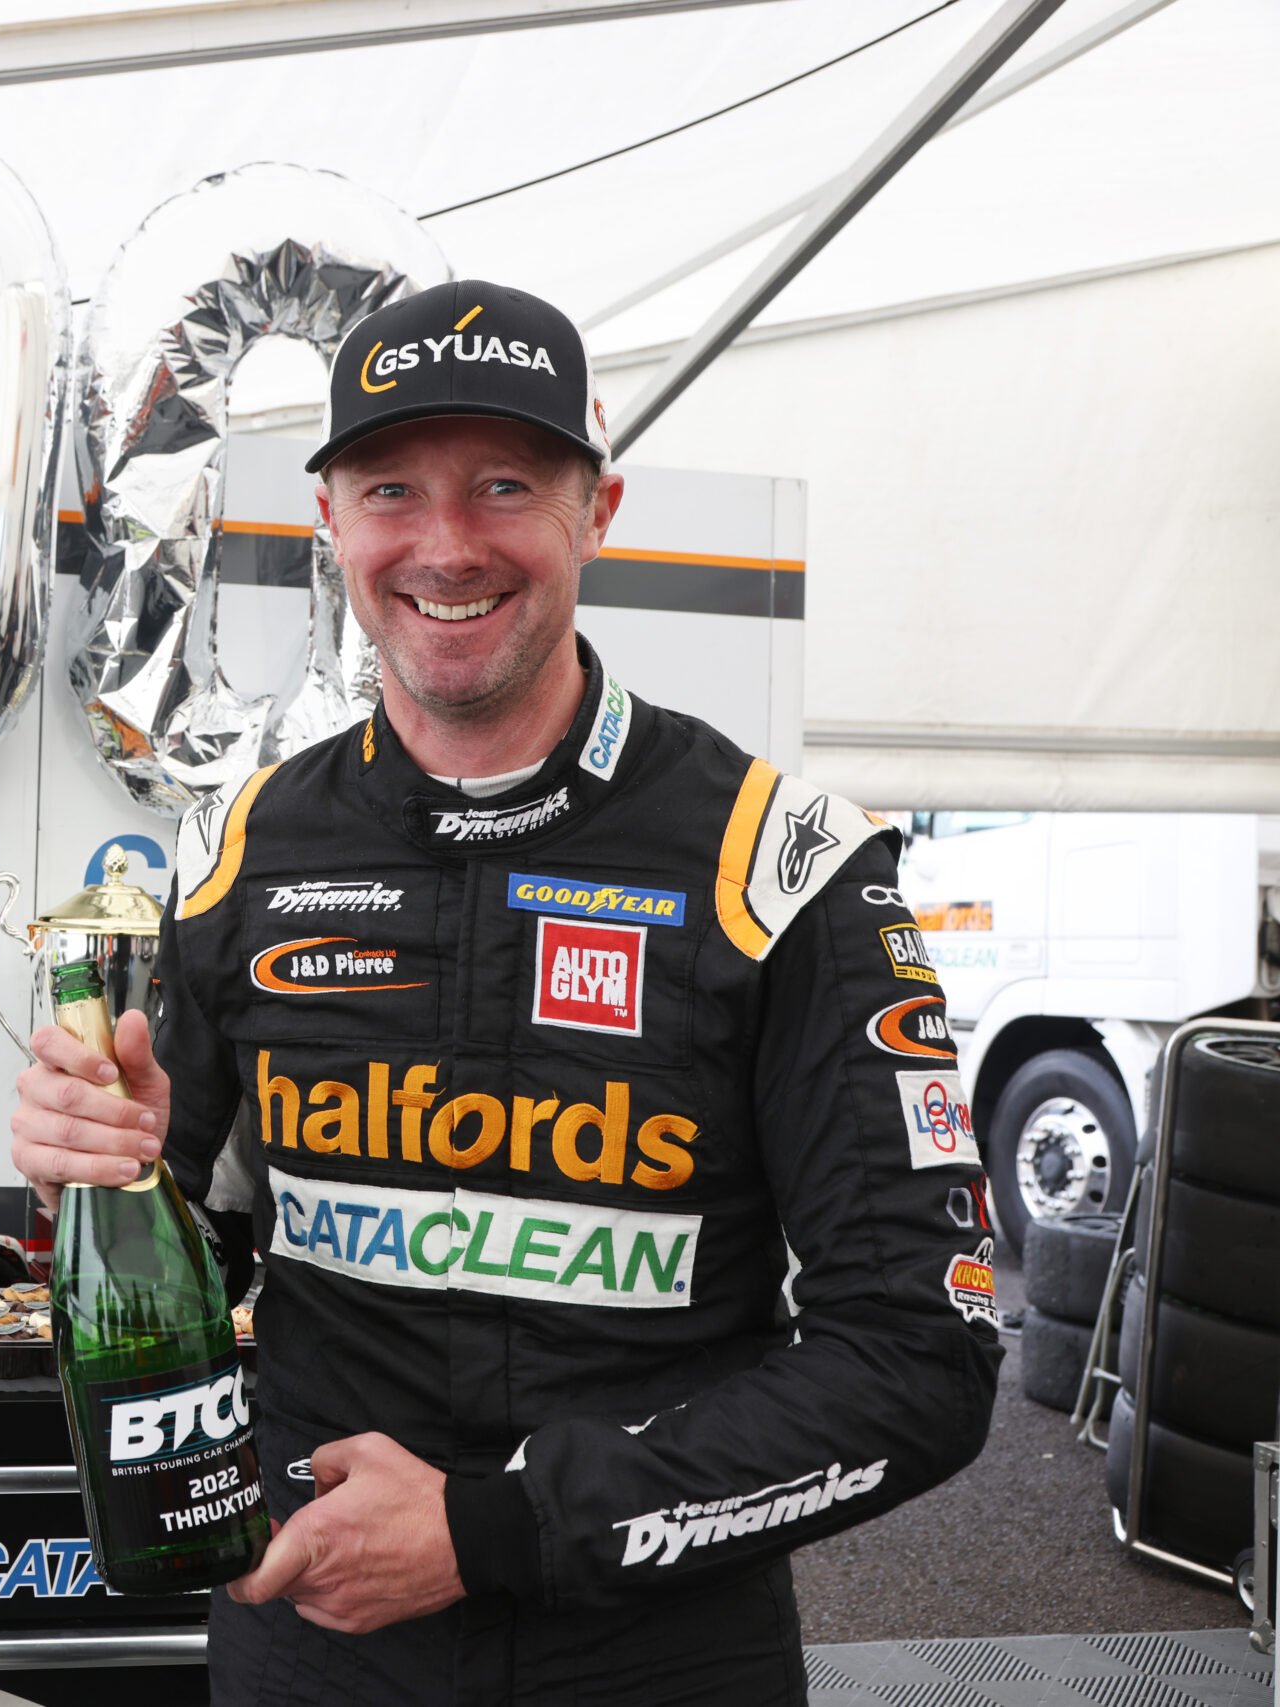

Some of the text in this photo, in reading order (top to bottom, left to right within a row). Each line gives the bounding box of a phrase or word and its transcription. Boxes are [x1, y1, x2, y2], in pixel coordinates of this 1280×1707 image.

[375, 333, 558, 377] GS YUASA
[267, 882, 406, 914] Dynamics
[516, 883, 676, 917] GOODYEAR
[290, 952, 394, 978] J&D Pierce
[552, 946, 629, 979] AUTO
[550, 971, 627, 1007] GLYM
[256, 1049, 703, 1192] halfords
[279, 1190, 690, 1294] CATACLEAN
[111, 1465, 151, 1477] BRITISH
[153, 1454, 201, 1472] TOURING
[204, 1447, 223, 1460] CAR
[188, 1465, 240, 1500] 2022
[159, 1480, 262, 1532] THRUXTON
[620, 1458, 889, 1567] Dynamics
[672, 1495, 744, 1521] team
